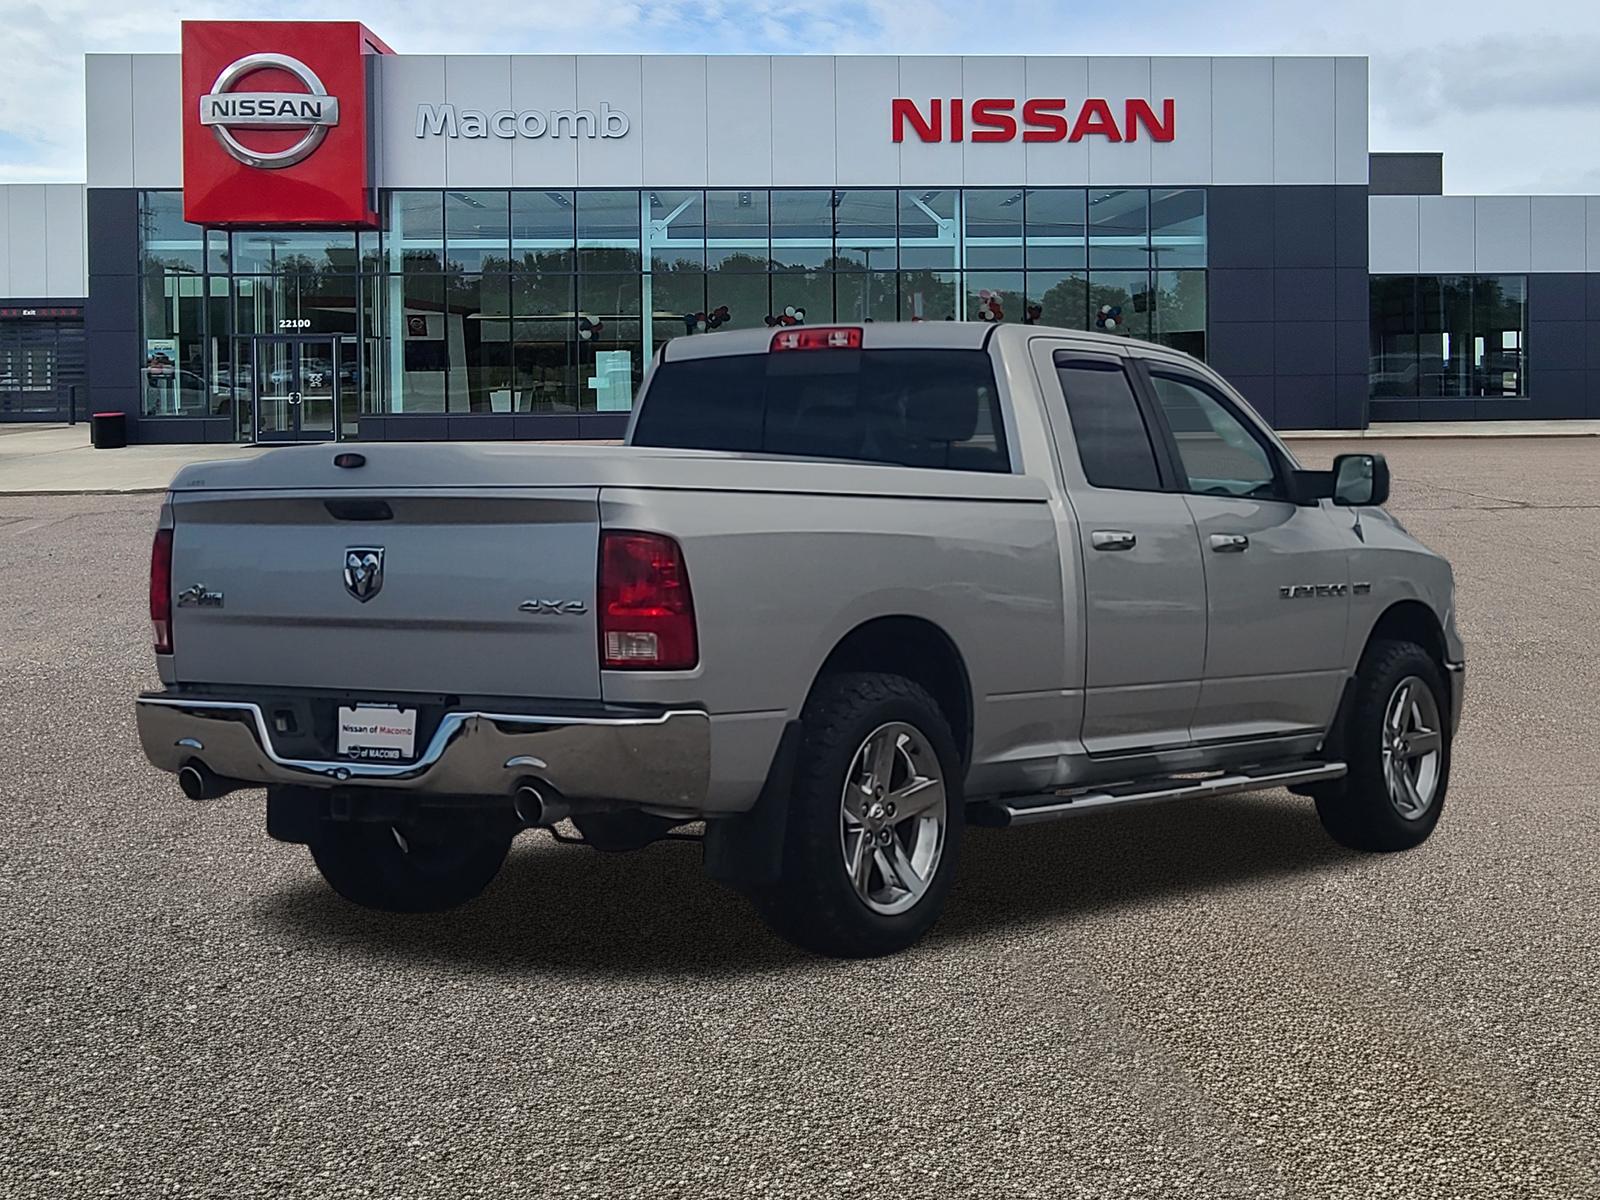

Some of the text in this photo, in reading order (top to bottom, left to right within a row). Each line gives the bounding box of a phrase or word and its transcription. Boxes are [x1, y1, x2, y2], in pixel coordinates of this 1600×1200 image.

[211, 100, 322, 118] NISSAN
[415, 101, 631, 139] Macomb
[892, 98, 1175, 143] NISSAN
[279, 319, 311, 328] 22100
[342, 724, 413, 736] Nissan of Macomb
[368, 749, 400, 759] MACOMB
